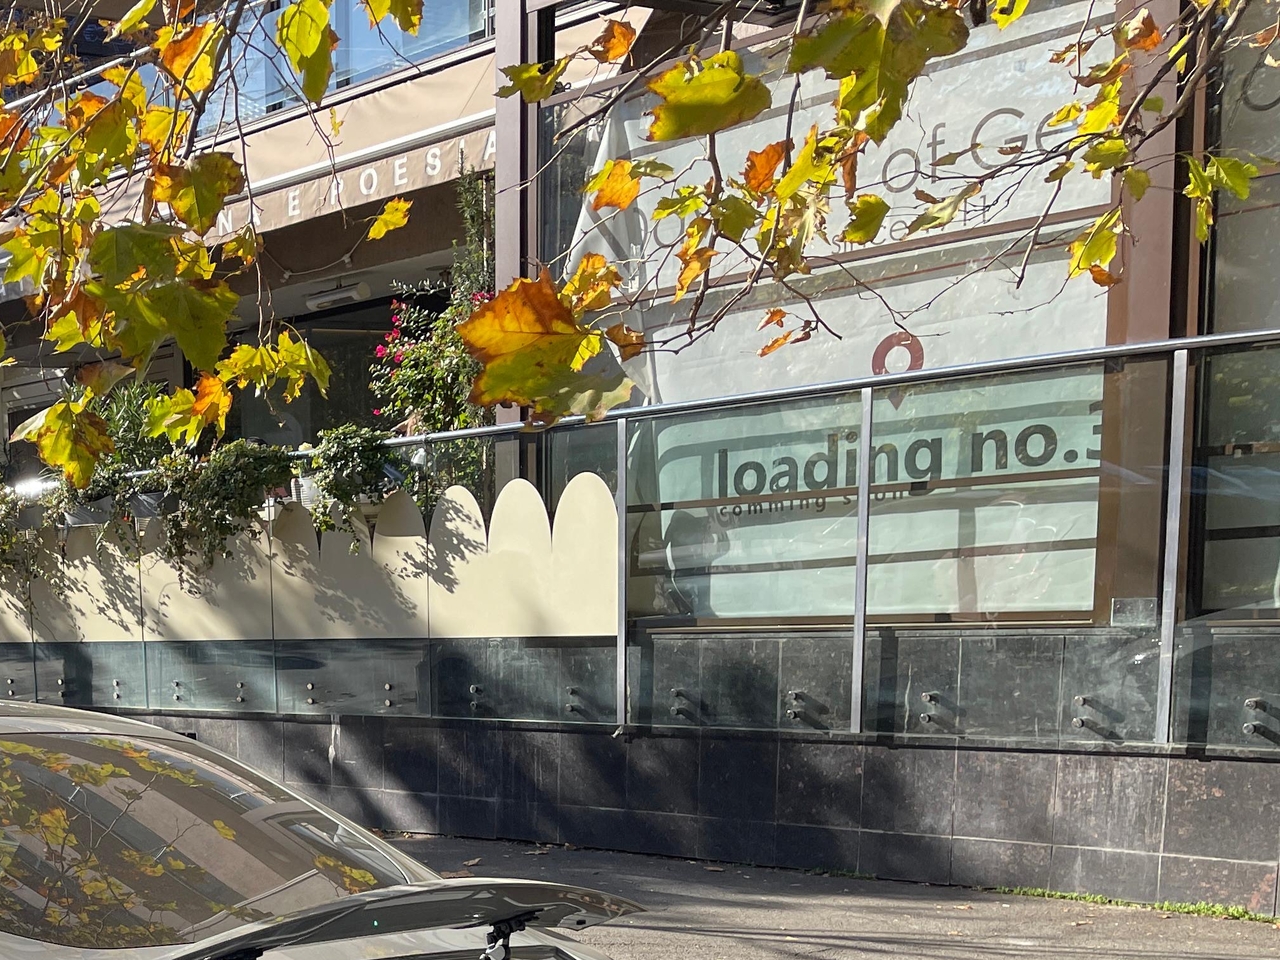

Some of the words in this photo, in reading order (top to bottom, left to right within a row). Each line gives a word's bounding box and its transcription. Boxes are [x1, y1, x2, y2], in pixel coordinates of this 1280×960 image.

[287, 190, 301, 216] E
[330, 130, 496, 205] POESIA
[882, 122, 947, 193] of
[719, 430, 943, 497] loading
